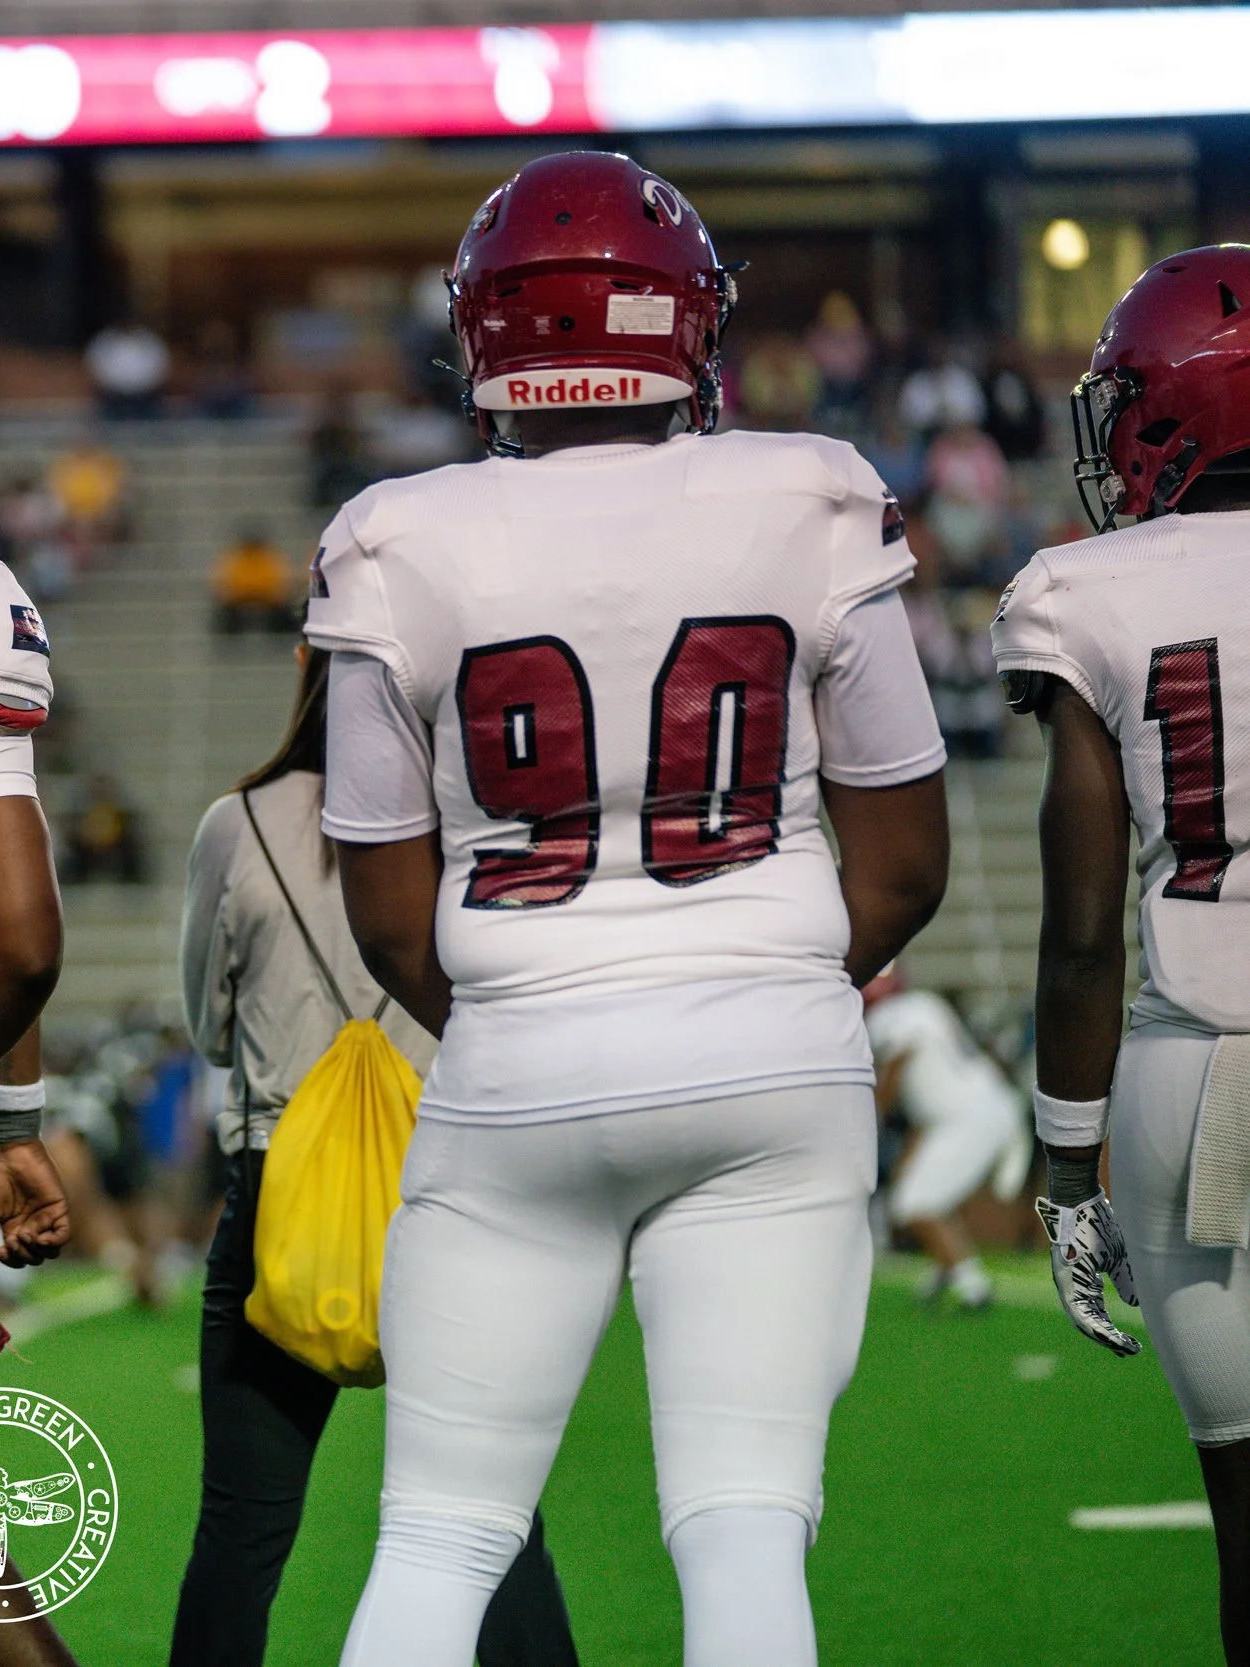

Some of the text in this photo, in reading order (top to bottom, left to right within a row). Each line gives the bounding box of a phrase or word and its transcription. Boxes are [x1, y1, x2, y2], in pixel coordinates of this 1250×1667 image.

[507, 378, 642, 405] Riddell
[456, 615, 796, 910] 90
[1143, 637, 1234, 902] 1
